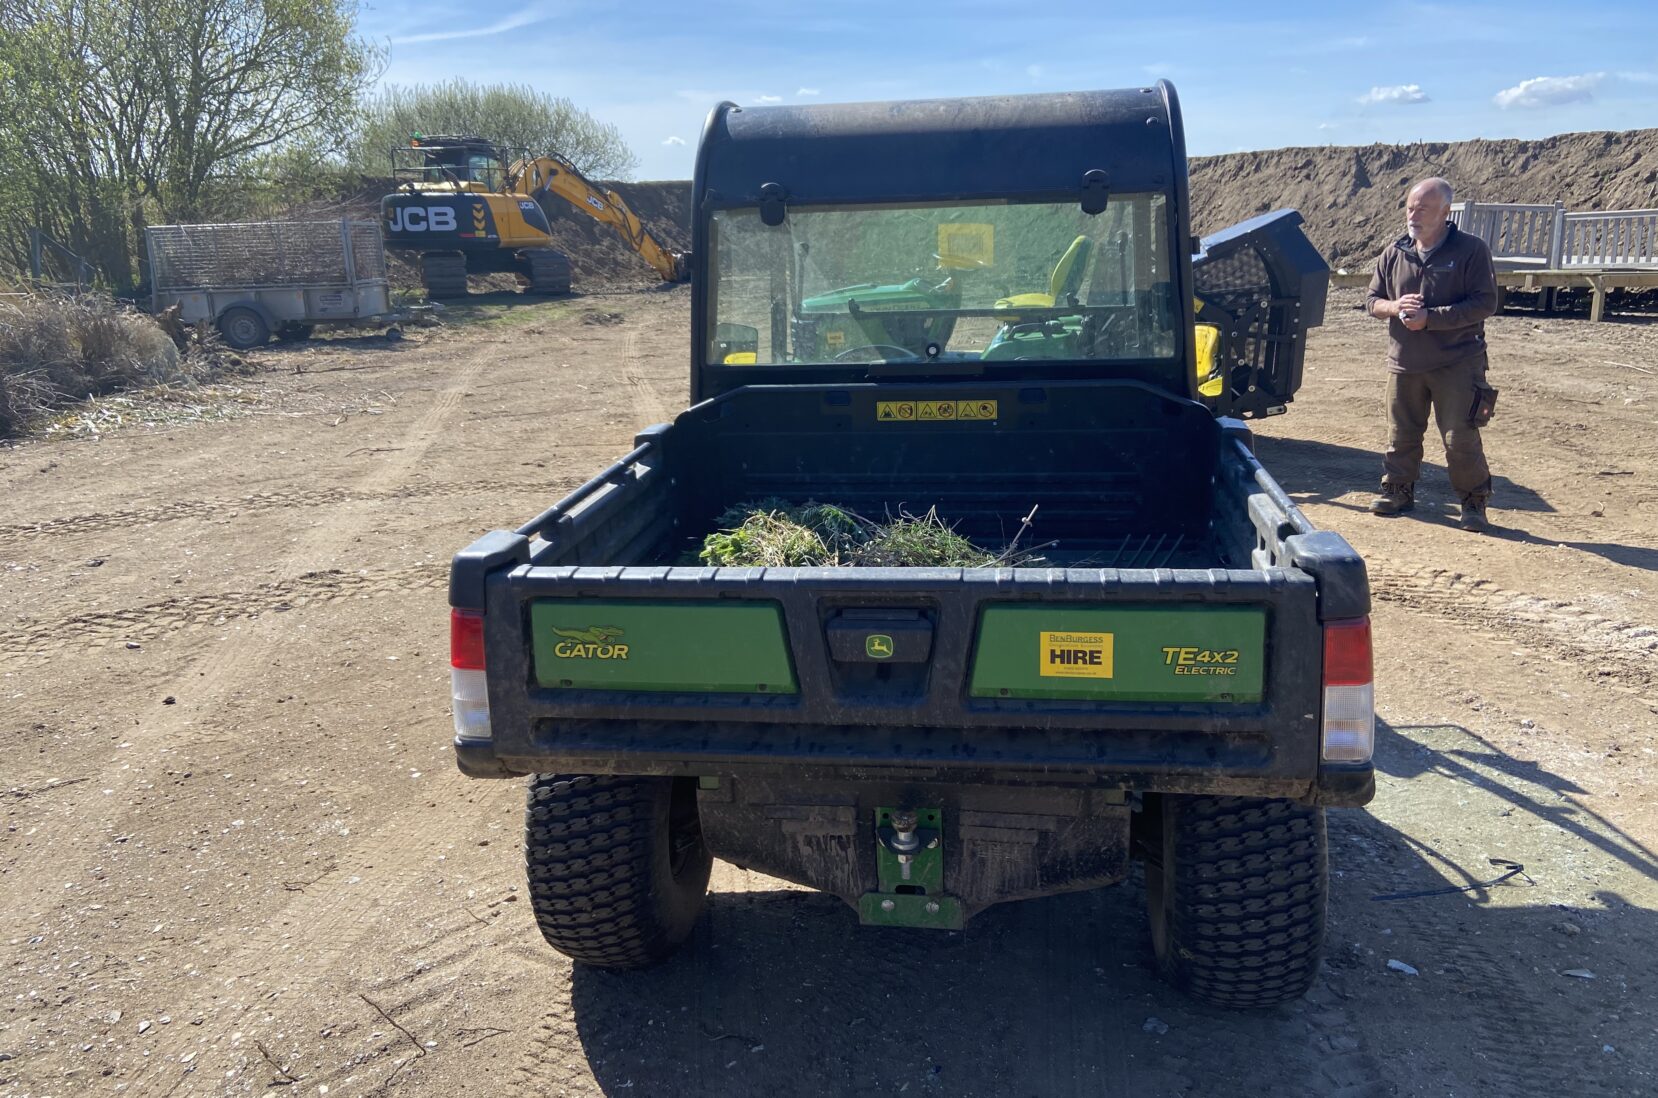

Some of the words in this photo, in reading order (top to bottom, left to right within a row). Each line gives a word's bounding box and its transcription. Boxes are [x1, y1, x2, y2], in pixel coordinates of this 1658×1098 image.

[519, 201, 535, 210] JCB
[587, 195, 604, 210] JCB
[389, 206, 458, 232] JCB
[554, 642, 630, 659] GATOR
[1050, 648, 1103, 666] HIRE
[1174, 665, 1237, 675] ELECTRIC
